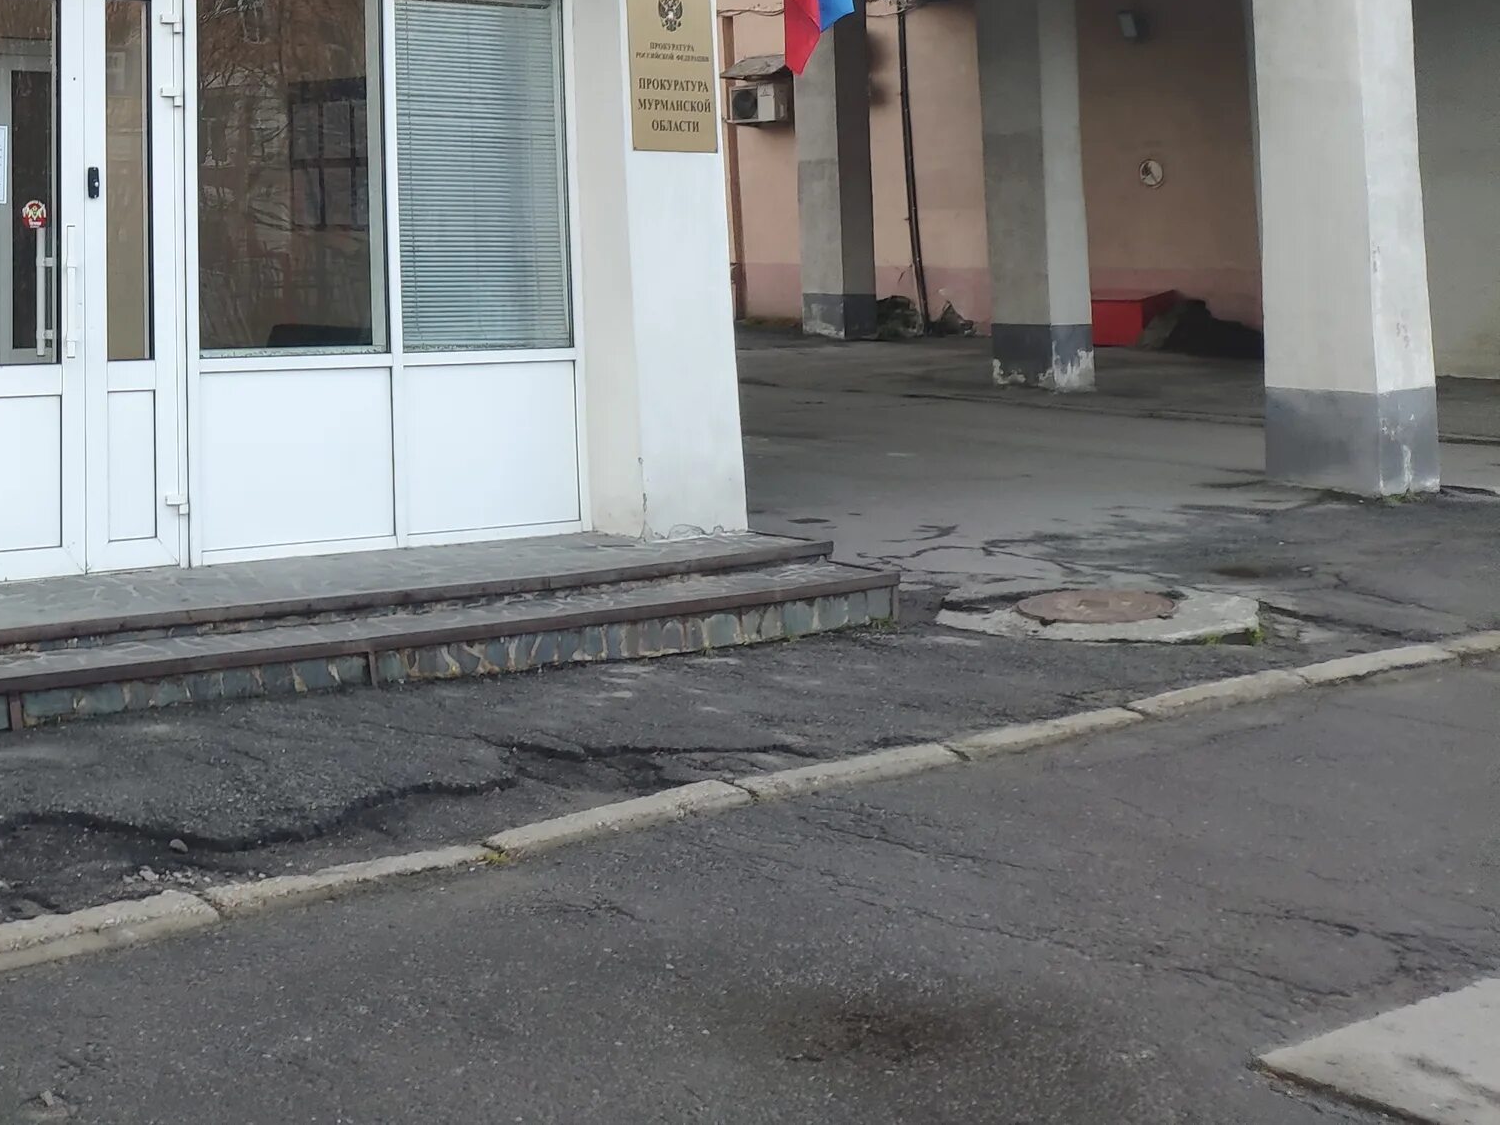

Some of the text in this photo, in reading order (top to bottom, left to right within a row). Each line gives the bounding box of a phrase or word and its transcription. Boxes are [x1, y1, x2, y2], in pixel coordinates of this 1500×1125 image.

[649, 42, 695, 52] ПРОКУРАТУРА
[638, 77, 709, 93] ПРОКУРАТУРА
[637, 98, 711, 113] МУРМАНСКОЙ
[651, 120, 700, 133] ОБЛАСТИ
